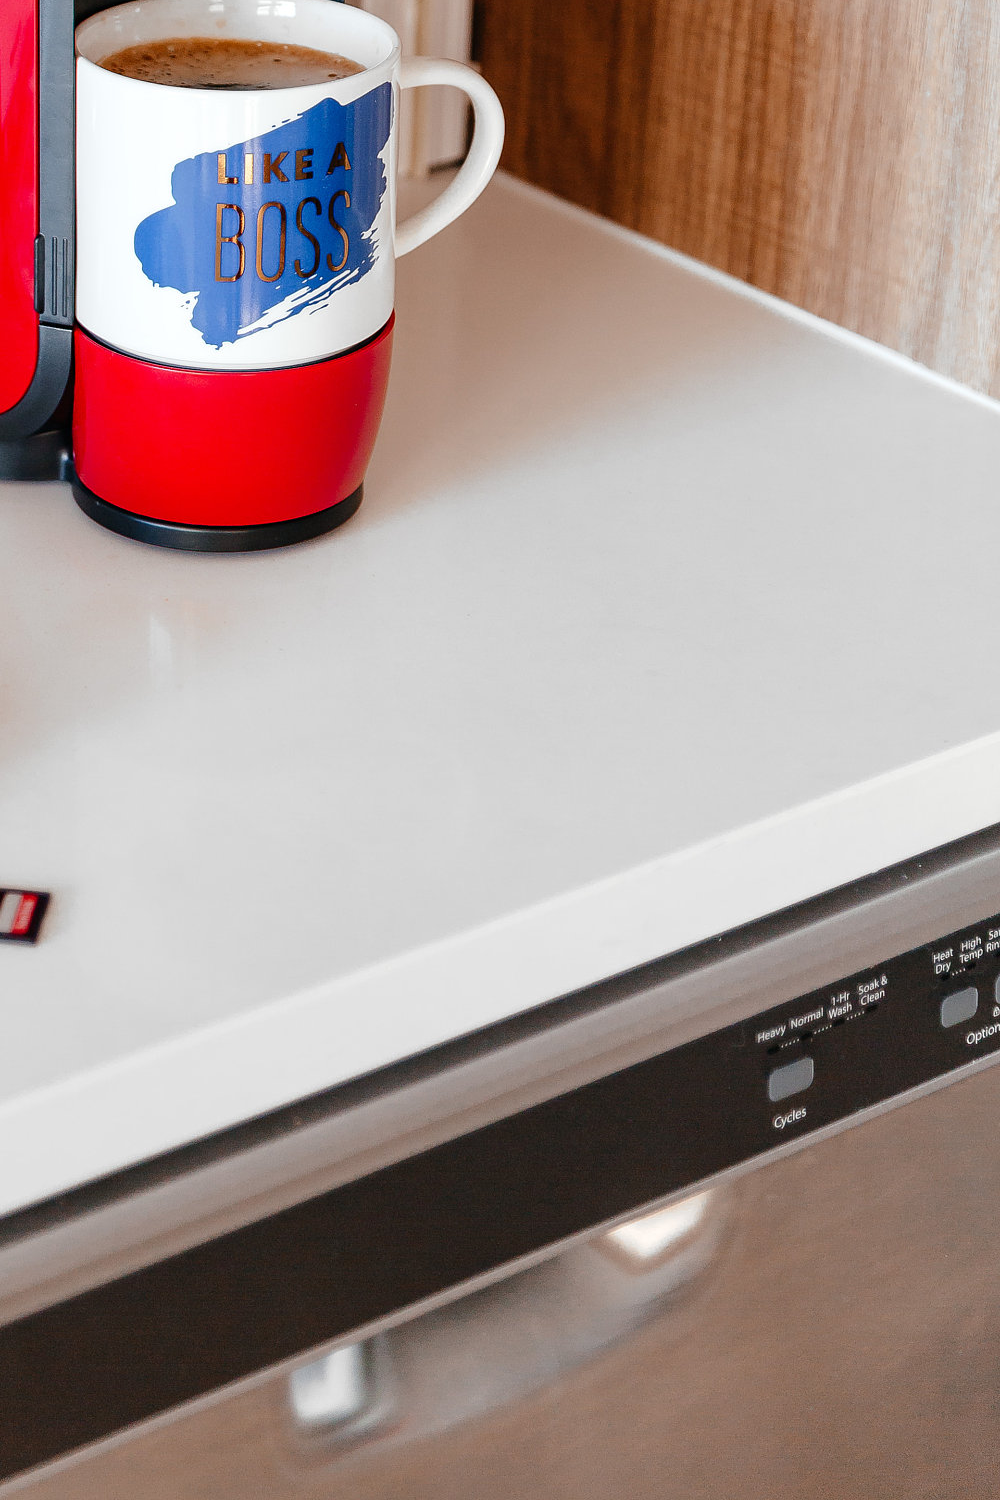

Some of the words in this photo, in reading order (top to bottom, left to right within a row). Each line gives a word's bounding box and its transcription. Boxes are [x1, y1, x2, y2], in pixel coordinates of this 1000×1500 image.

[217, 148, 314, 186] LIKE
[326, 141, 352, 176] A
[214, 189, 352, 283] BOSS
[960, 935, 982, 952] High
[933, 947, 954, 964] Heat
[959, 947, 984, 964] Temp
[935, 961, 952, 975] Dry
[858, 978, 880, 996] Soak
[880, 975, 888, 986] &
[831, 992, 851, 1006] 1-Hr
[860, 989, 886, 1006] Clean
[790, 1007, 824, 1030] Normal
[828, 1002, 853, 1020] Wash
[757, 1024, 787, 1044] Heavy
[774, 1106, 807, 1130] Cycles
